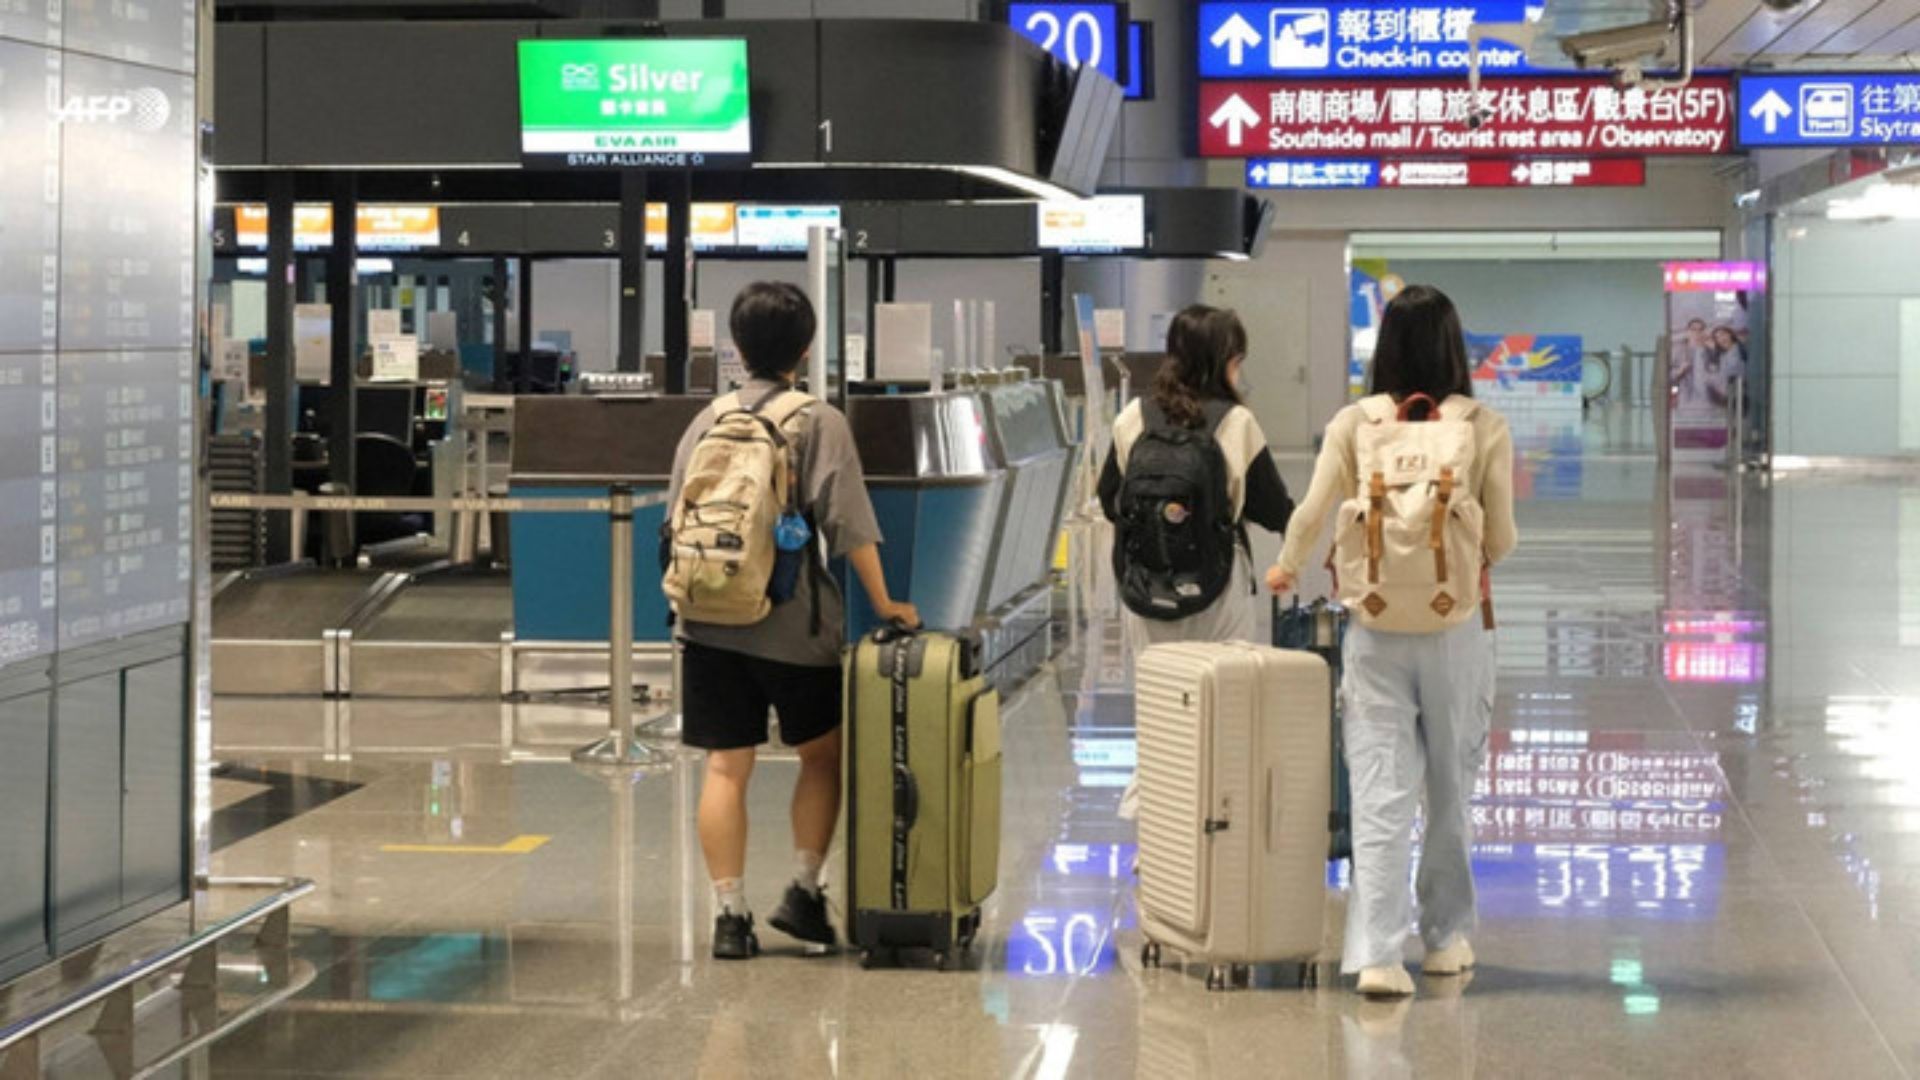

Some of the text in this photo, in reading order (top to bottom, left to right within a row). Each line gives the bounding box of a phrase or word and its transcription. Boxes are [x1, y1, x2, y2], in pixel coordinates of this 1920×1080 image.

[1025, 10, 1102, 71] 20
[1336, 46, 1529, 68] Check-in counter
[609, 63, 703, 92] Silver
[819, 119, 832, 152] 1
[1269, 126, 1366, 149] Southside
[1370, 126, 1412, 148] mall
[1429, 126, 1495, 148] Tourist
[1499, 128, 1537, 148] rest
[1540, 130, 1583, 148] area
[1601, 124, 1726, 152] Observatory
[567, 153, 687, 166] STAR ALLIANCE
[458, 230, 470, 247] 4
[603, 230, 615, 248] 3
[856, 230, 868, 248] 2
